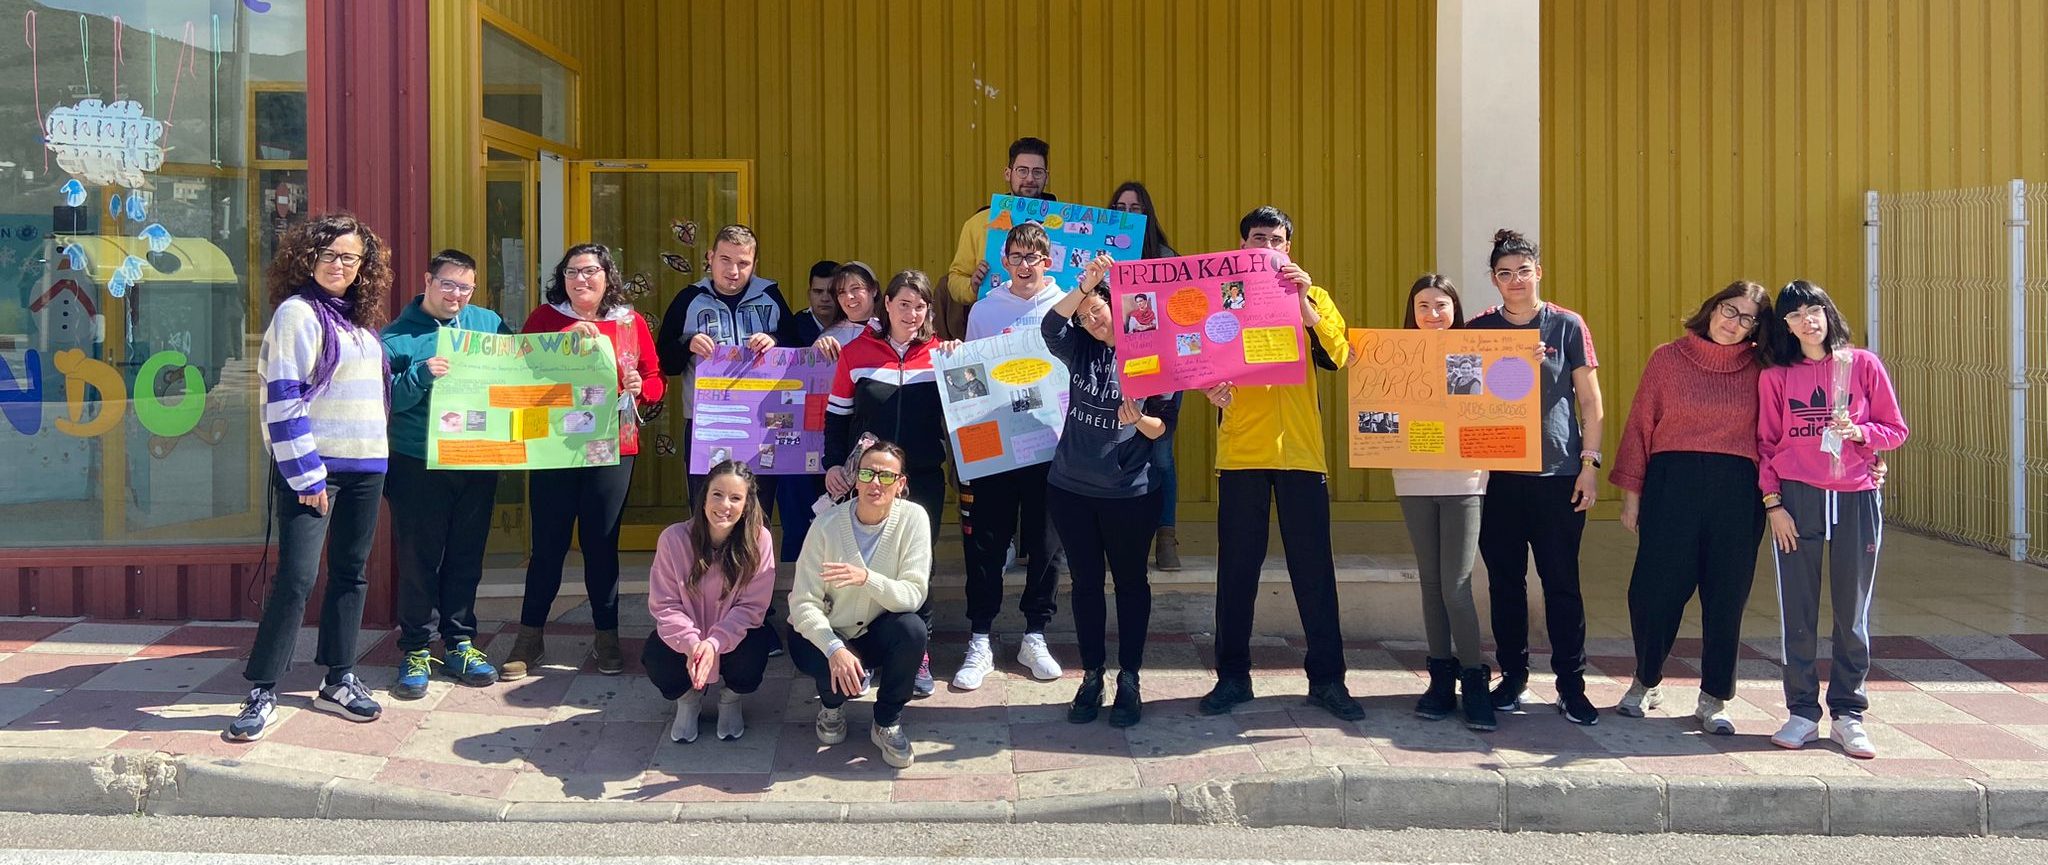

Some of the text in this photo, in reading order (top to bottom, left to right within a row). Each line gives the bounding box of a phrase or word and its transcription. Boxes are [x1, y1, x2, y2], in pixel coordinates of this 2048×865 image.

[1000, 197, 1049, 217] COCO
[1060, 203, 1134, 230] CHANEL
[1119, 260, 1193, 285] FRIDA
[697, 304, 773, 340] CITY
[450, 330, 534, 359] VIRGINIA
[1350, 331, 1427, 369] ROSA
[1073, 373, 1120, 400] CHAUIO
[1353, 365, 1433, 400] PARKS
[1070, 406, 1125, 430] AURÉLIE
[1789, 423, 1829, 437] adid
